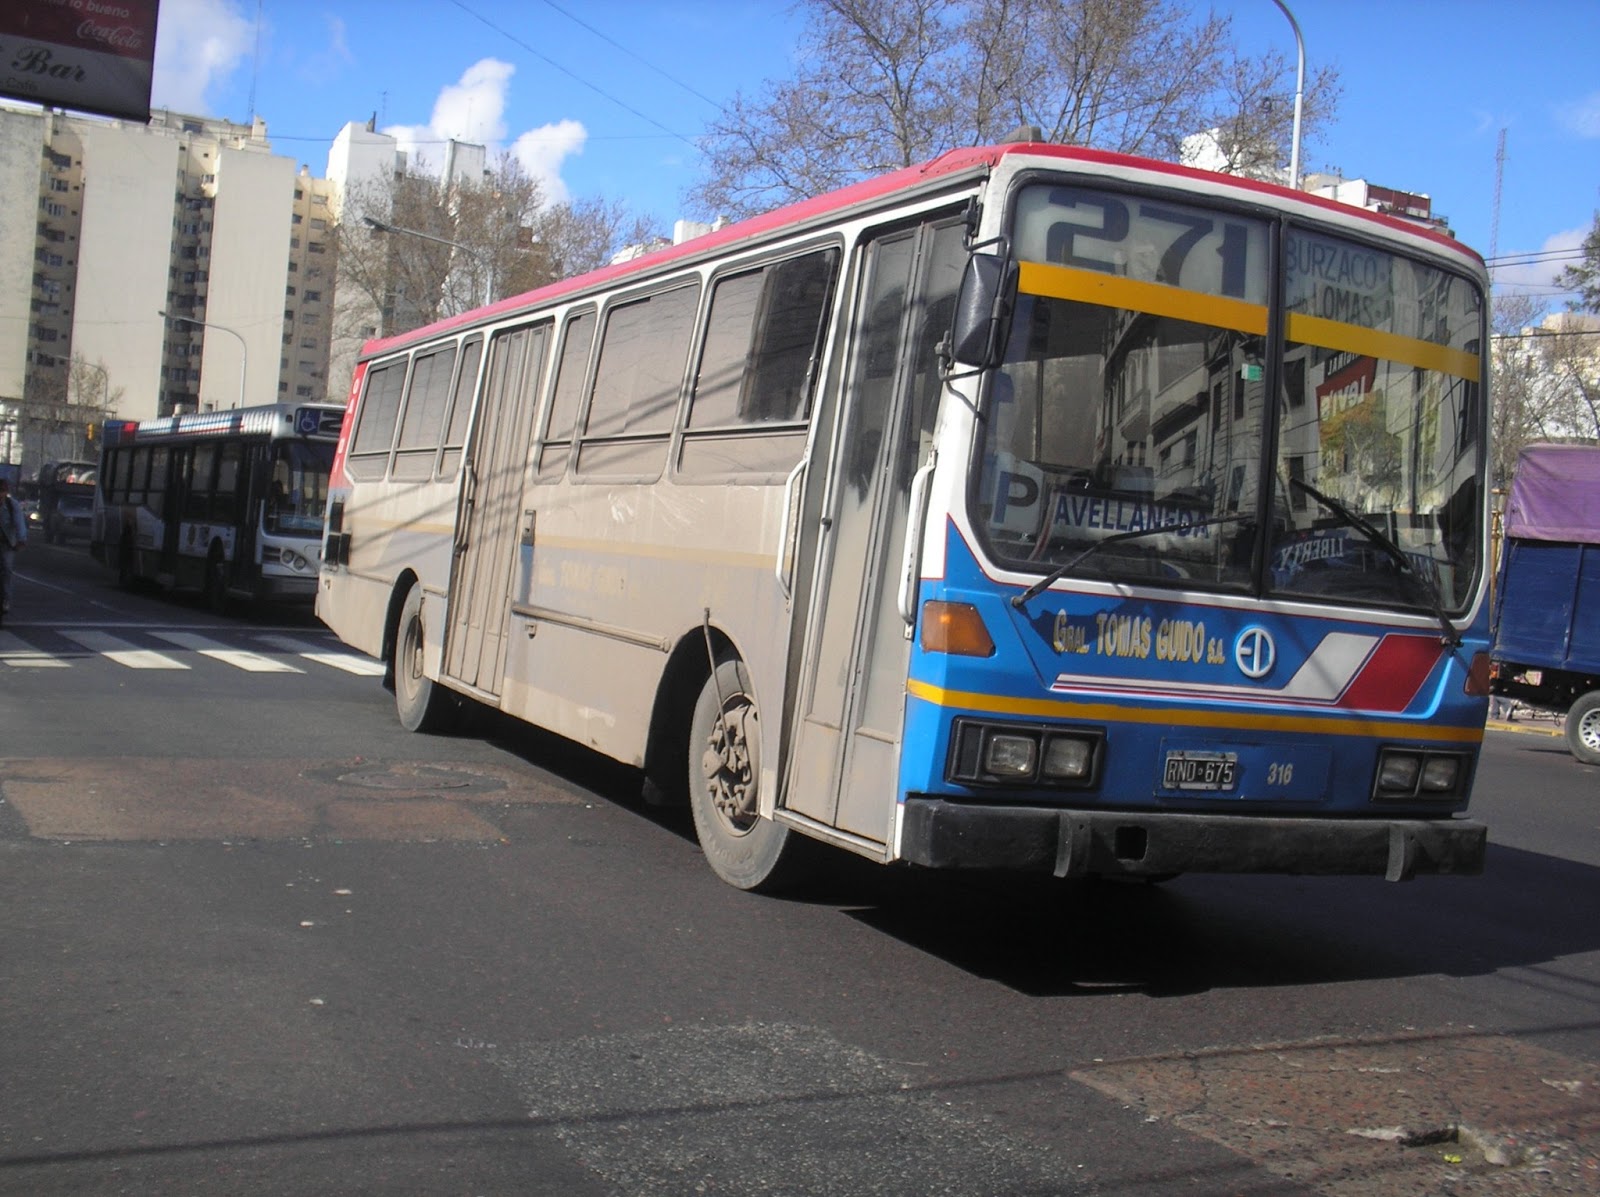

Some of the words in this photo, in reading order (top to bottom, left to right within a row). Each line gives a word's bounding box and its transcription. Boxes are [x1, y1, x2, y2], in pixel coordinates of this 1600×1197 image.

[87, 0, 130, 18] bueno
[11, 46, 86, 82] Bar
[1045, 187, 1249, 299] 271
[1285, 238, 1378, 289] BURZACO
[1313, 282, 1375, 328] LOMAS
[992, 471, 1039, 525] P
[1096, 612, 1151, 659] TOMAS
[1155, 618, 1205, 663] GUIDO
[1205, 761, 1234, 783] 675
[1266, 761, 1294, 786] 316
